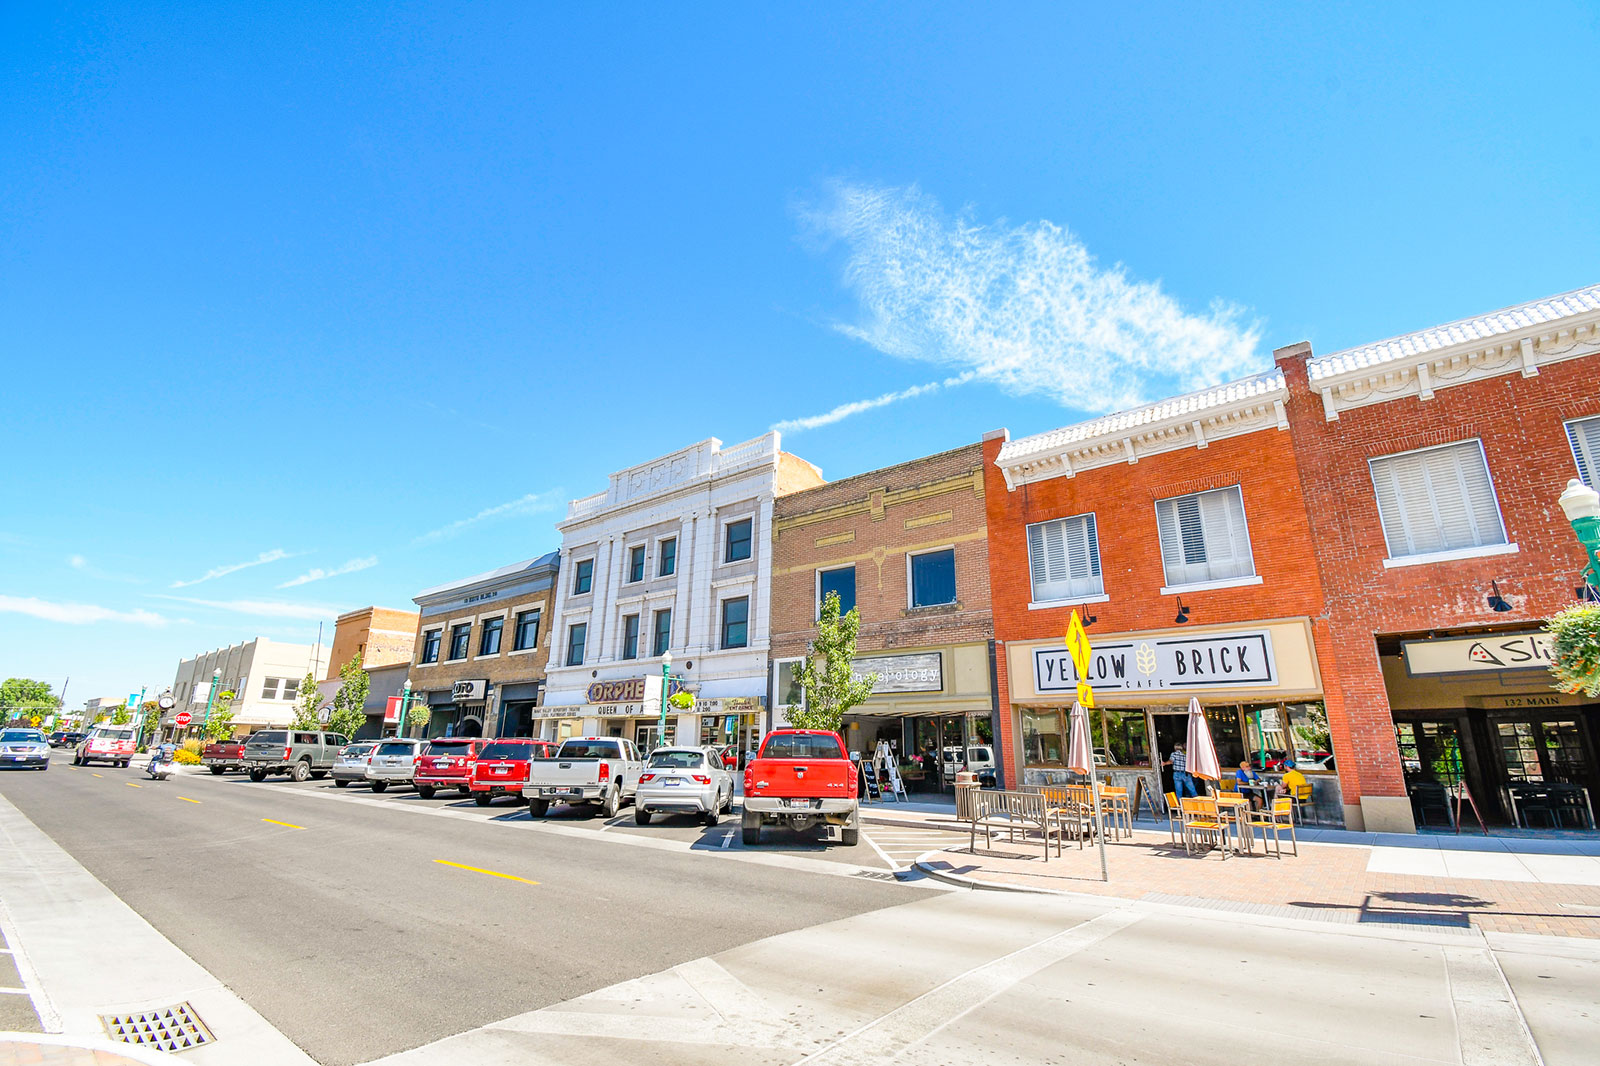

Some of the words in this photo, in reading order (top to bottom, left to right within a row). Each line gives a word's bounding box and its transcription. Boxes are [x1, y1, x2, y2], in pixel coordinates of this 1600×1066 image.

[1500, 636, 1551, 662] Sli
[1175, 646, 1251, 676] BRICK
[1126, 679, 1164, 689] CAFE
[1504, 698, 1522, 706] 132
[1527, 697, 1559, 705] MAIN
[597, 705, 617, 715] QUEEN
[625, 705, 633, 714] OF
